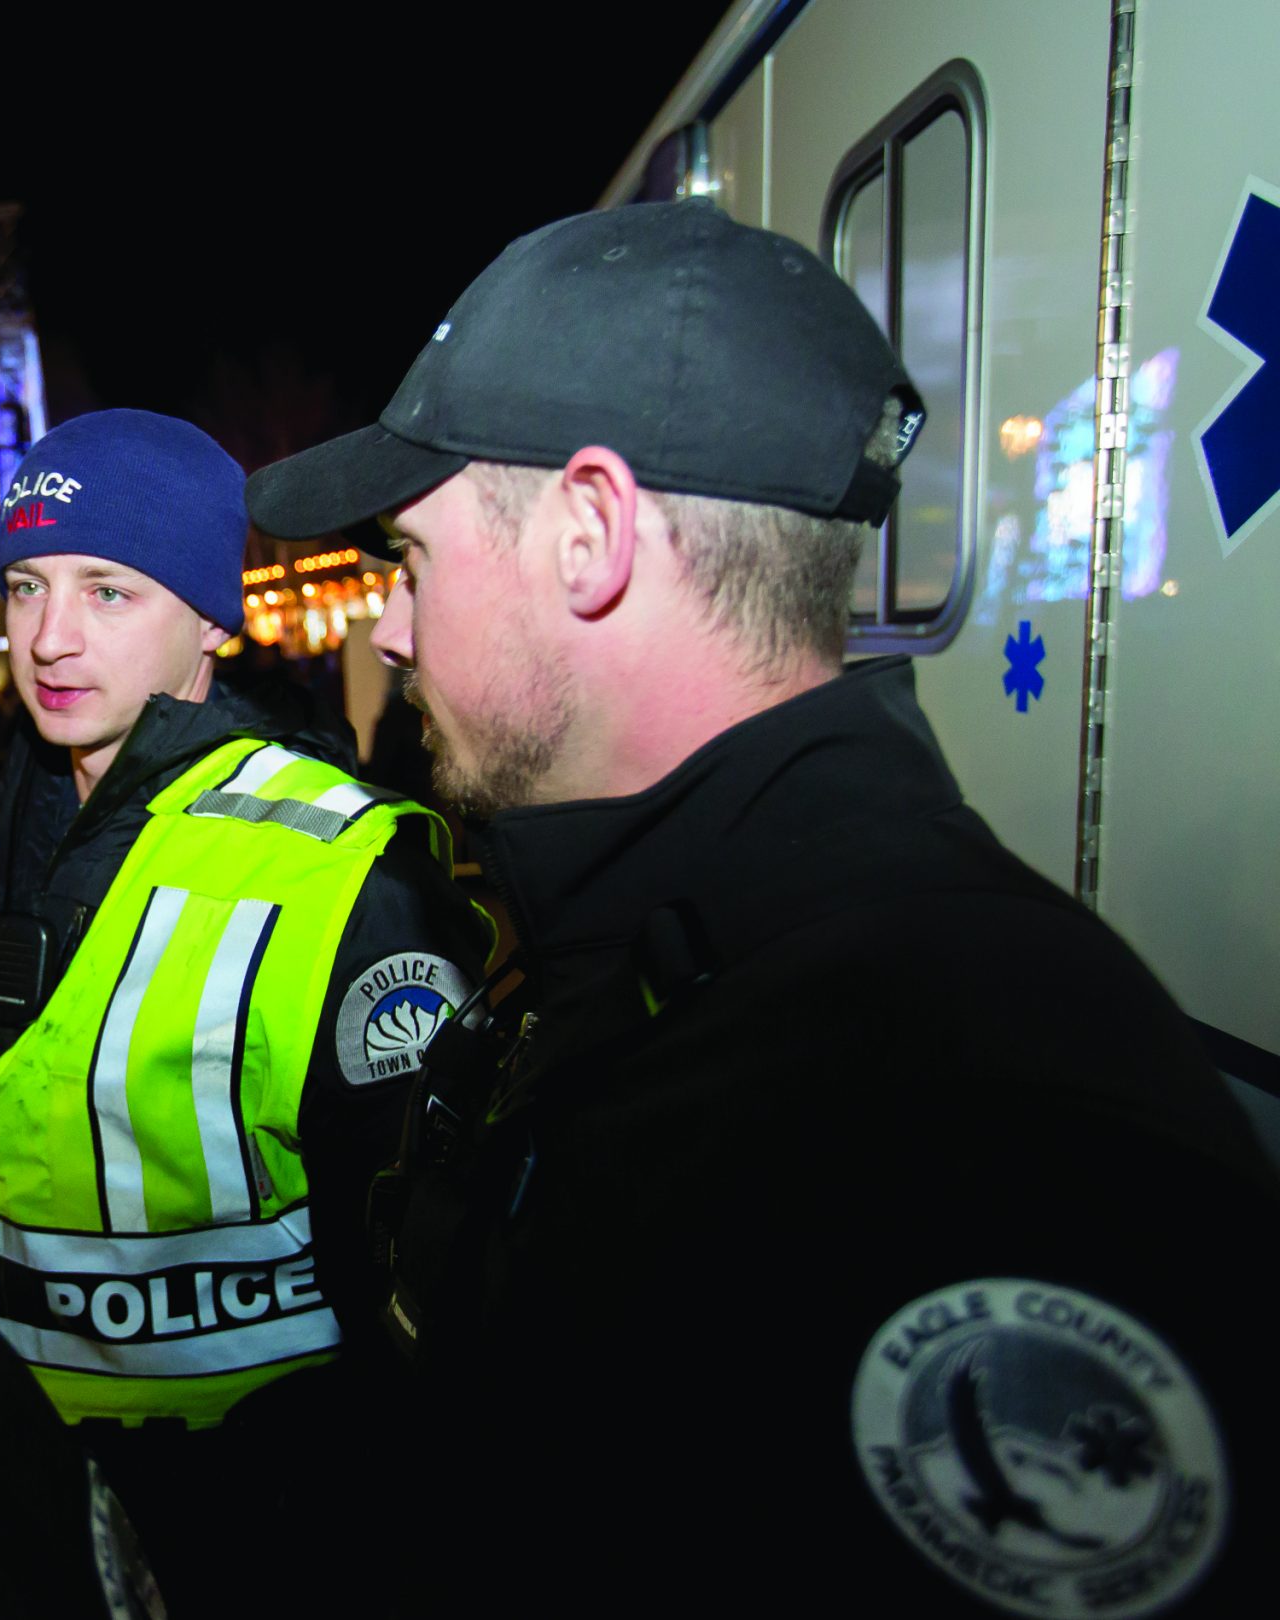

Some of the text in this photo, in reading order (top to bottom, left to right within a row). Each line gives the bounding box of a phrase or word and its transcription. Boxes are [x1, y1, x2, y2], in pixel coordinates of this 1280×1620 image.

[359, 959, 440, 1003] POLICE
[367, 1052, 412, 1079] TOWN
[44, 1255, 324, 1340] POLICE
[881, 1289, 1175, 1390] EAGLE COUNTY
